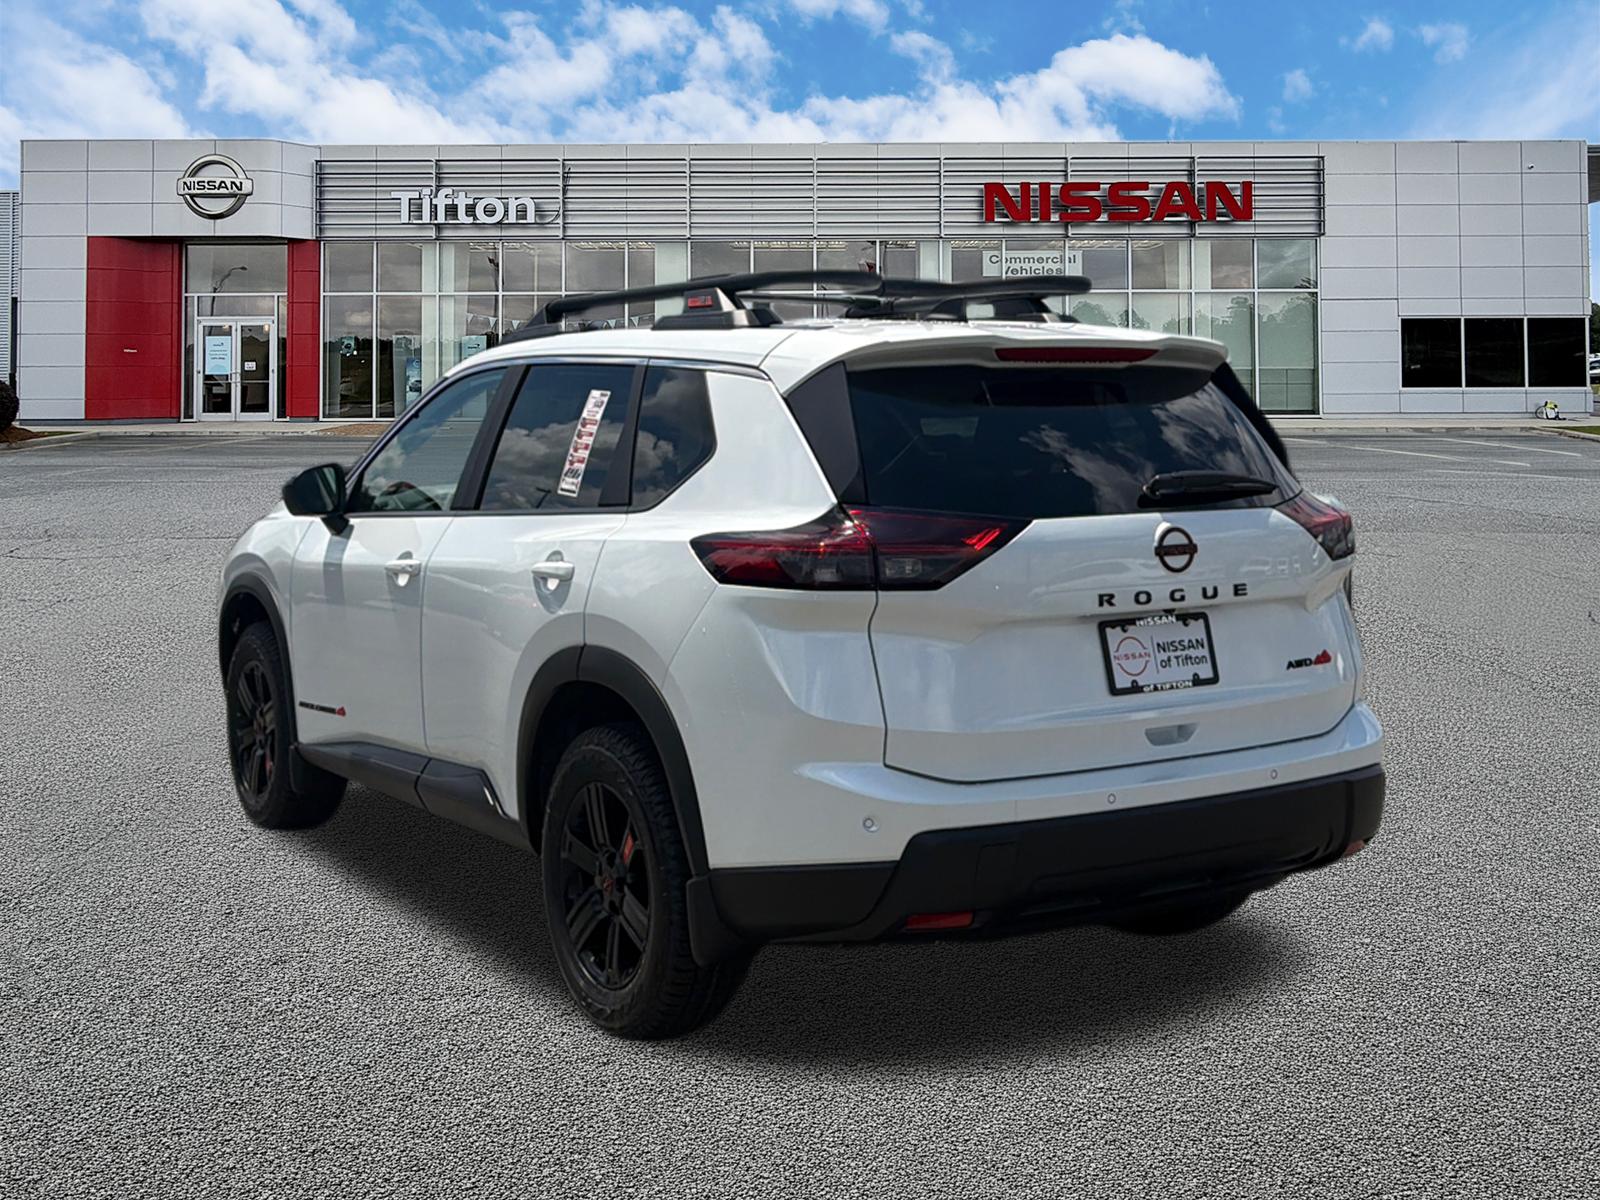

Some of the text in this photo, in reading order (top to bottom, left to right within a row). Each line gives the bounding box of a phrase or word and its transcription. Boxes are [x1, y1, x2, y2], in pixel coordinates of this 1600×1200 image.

[183, 180, 243, 191] NISSAN
[391, 188, 536, 224] Tifton
[983, 181, 1253, 222] NISSAN
[1098, 583, 1248, 607] ROGUE
[1135, 615, 1177, 627] NISSAN
[1156, 638, 1205, 654] NISSAN
[1113, 652, 1151, 661] NISSAN
[1159, 654, 1208, 669] of Tifton
[1157, 680, 1193, 692] TIFTON
